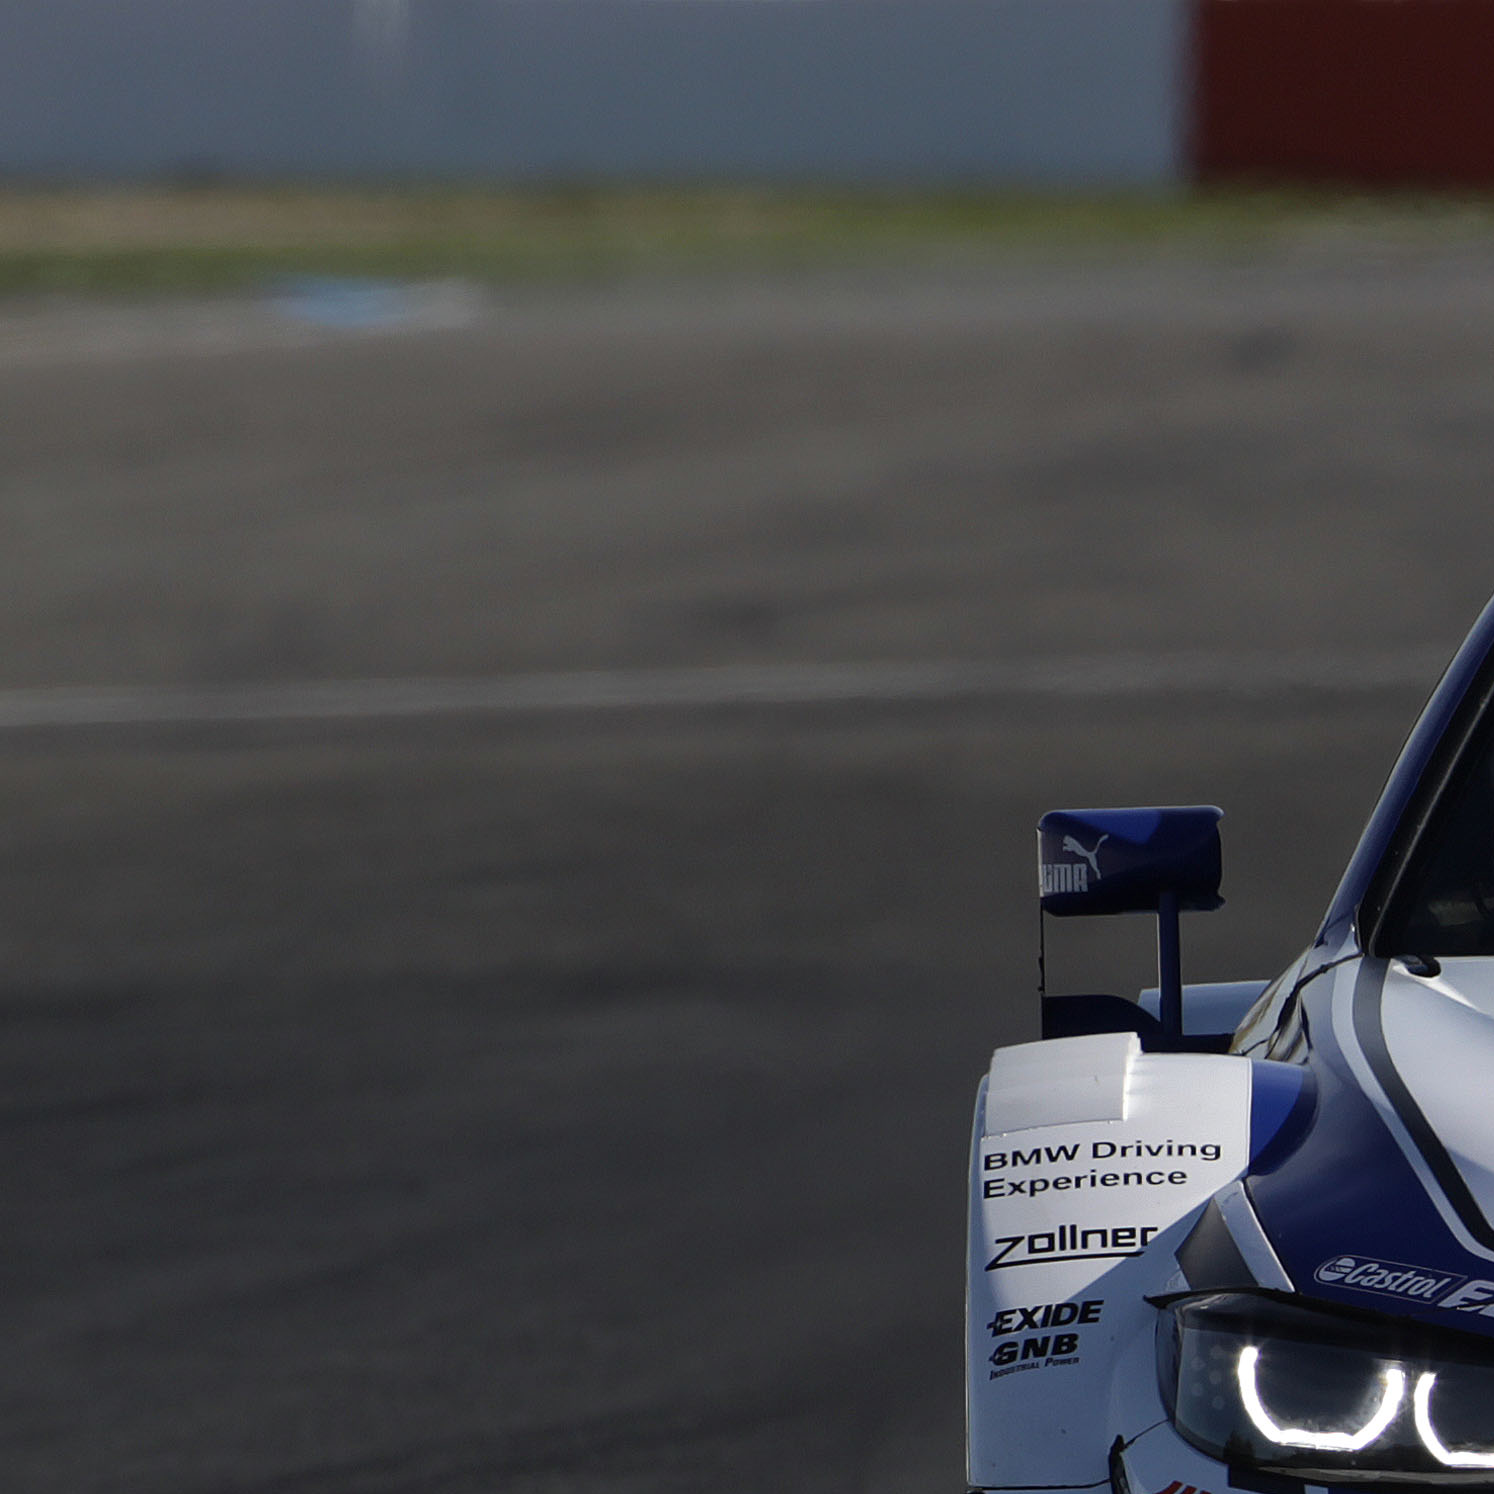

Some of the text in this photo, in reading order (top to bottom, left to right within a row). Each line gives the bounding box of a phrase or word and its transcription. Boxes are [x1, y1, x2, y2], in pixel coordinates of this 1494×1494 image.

[984, 1139, 1222, 1172] BMW Driving
[983, 1169, 1188, 1200] Experience
[1348, 1262, 1453, 1299] Castrol
[987, 1299, 1105, 1338] EXIDE
[989, 1333, 1079, 1366] GNB
